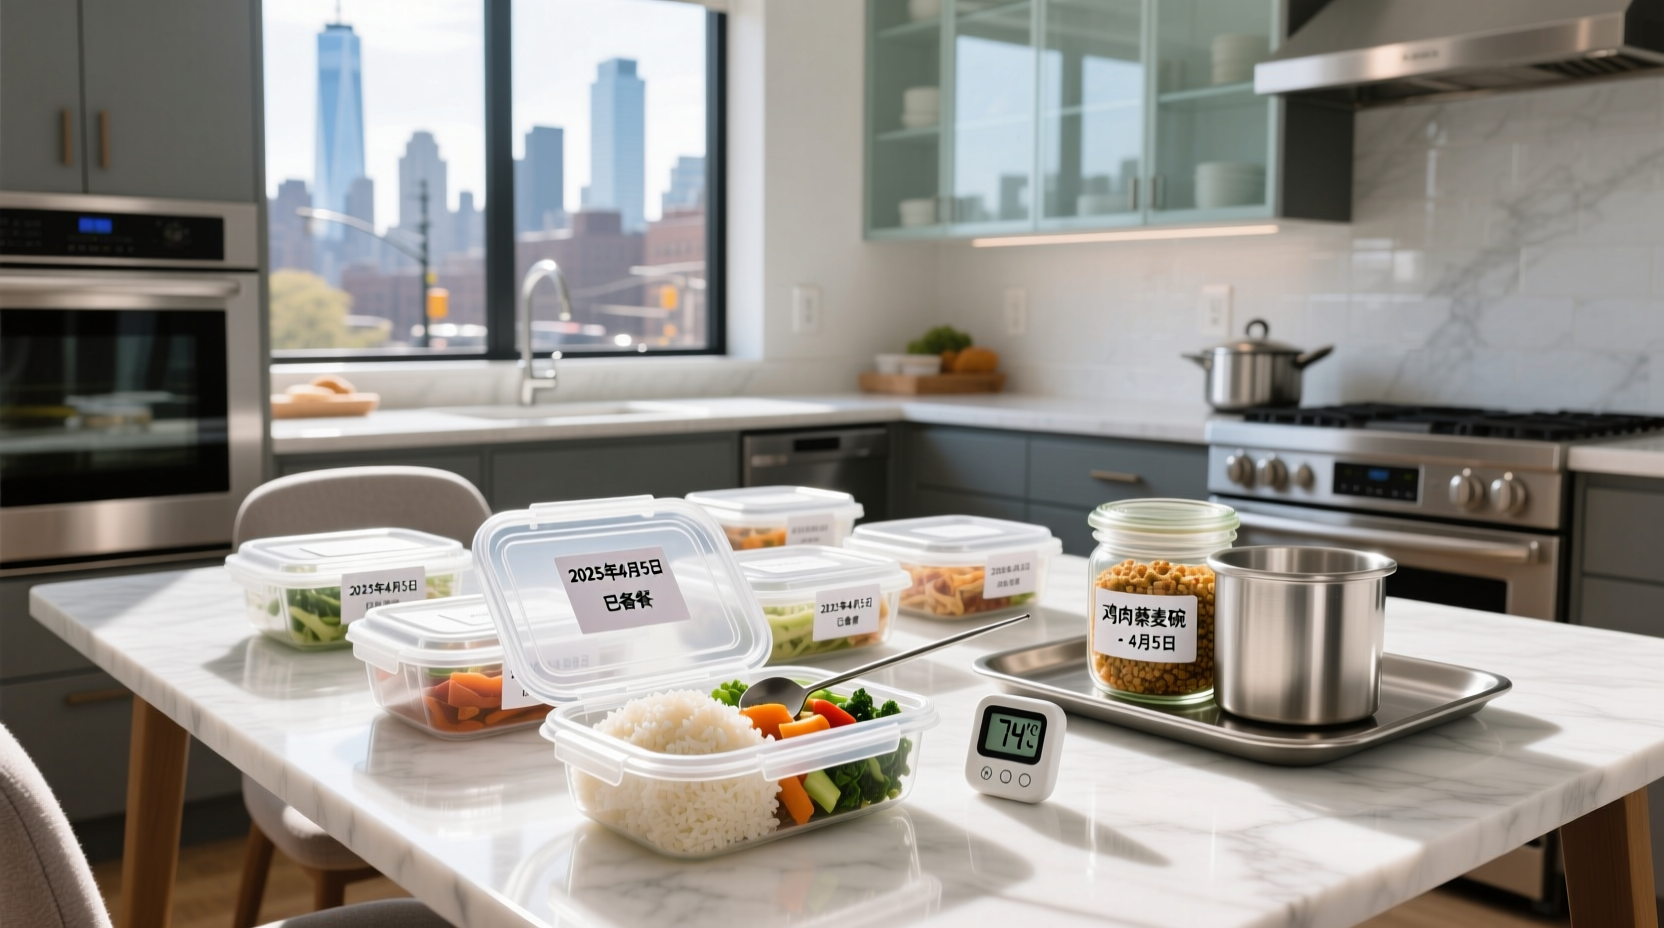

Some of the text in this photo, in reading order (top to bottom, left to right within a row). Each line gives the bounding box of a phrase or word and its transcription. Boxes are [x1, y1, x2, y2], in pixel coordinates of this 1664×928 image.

[568, 558, 663, 583] 2025年4月5日
[349, 579, 417, 596] 2025年4月5日
[1128, 633, 1176, 652] 4月5日
